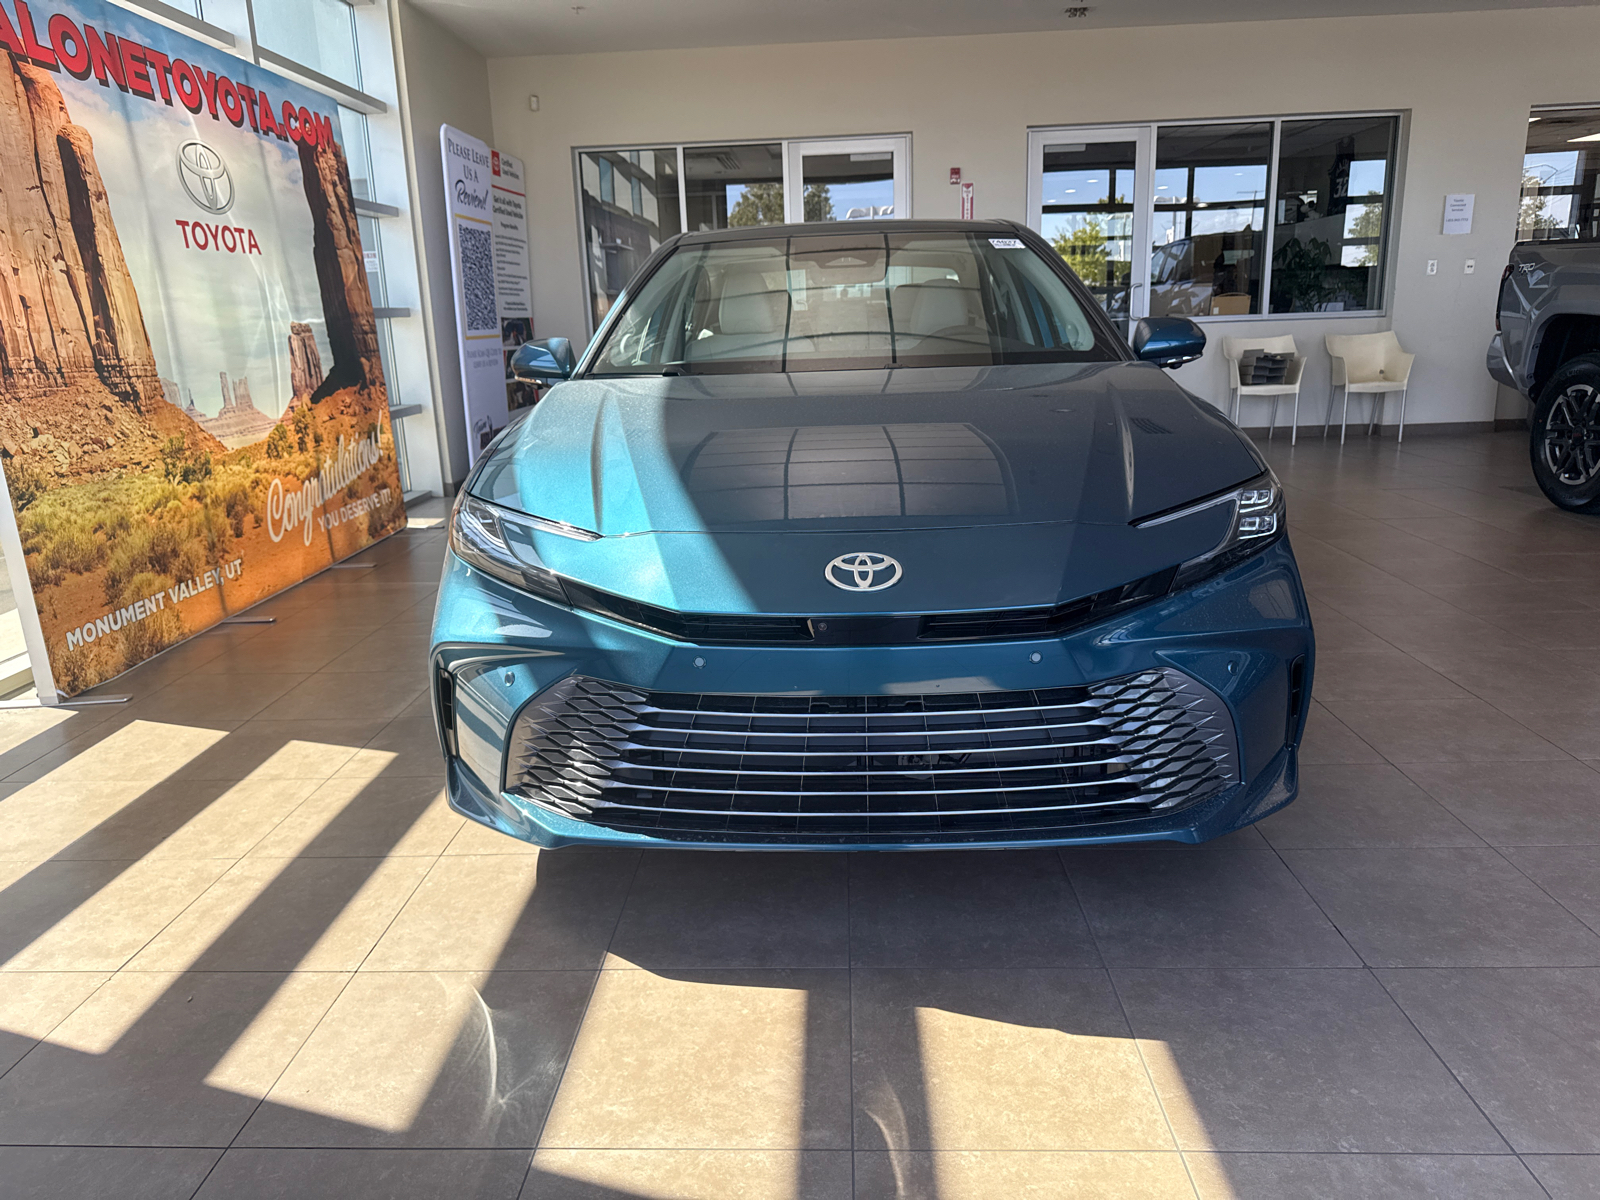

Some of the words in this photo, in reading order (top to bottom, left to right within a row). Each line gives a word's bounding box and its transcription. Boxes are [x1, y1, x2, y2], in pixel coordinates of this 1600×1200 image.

[447, 137, 471, 162] PLEASE
[473, 169, 479, 183] A
[175, 219, 262, 255] TOYOTA
[1518, 262, 1536, 274] TRD
[267, 408, 384, 547] Congratulations!
[317, 510, 340, 532] YOU
[340, 493, 381, 523] DESERVE
[380, 488, 392, 505] IT!
[65, 591, 166, 652] MONUMENT
[168, 567, 225, 604] VALLEY,
[225, 558, 242, 579] UT
